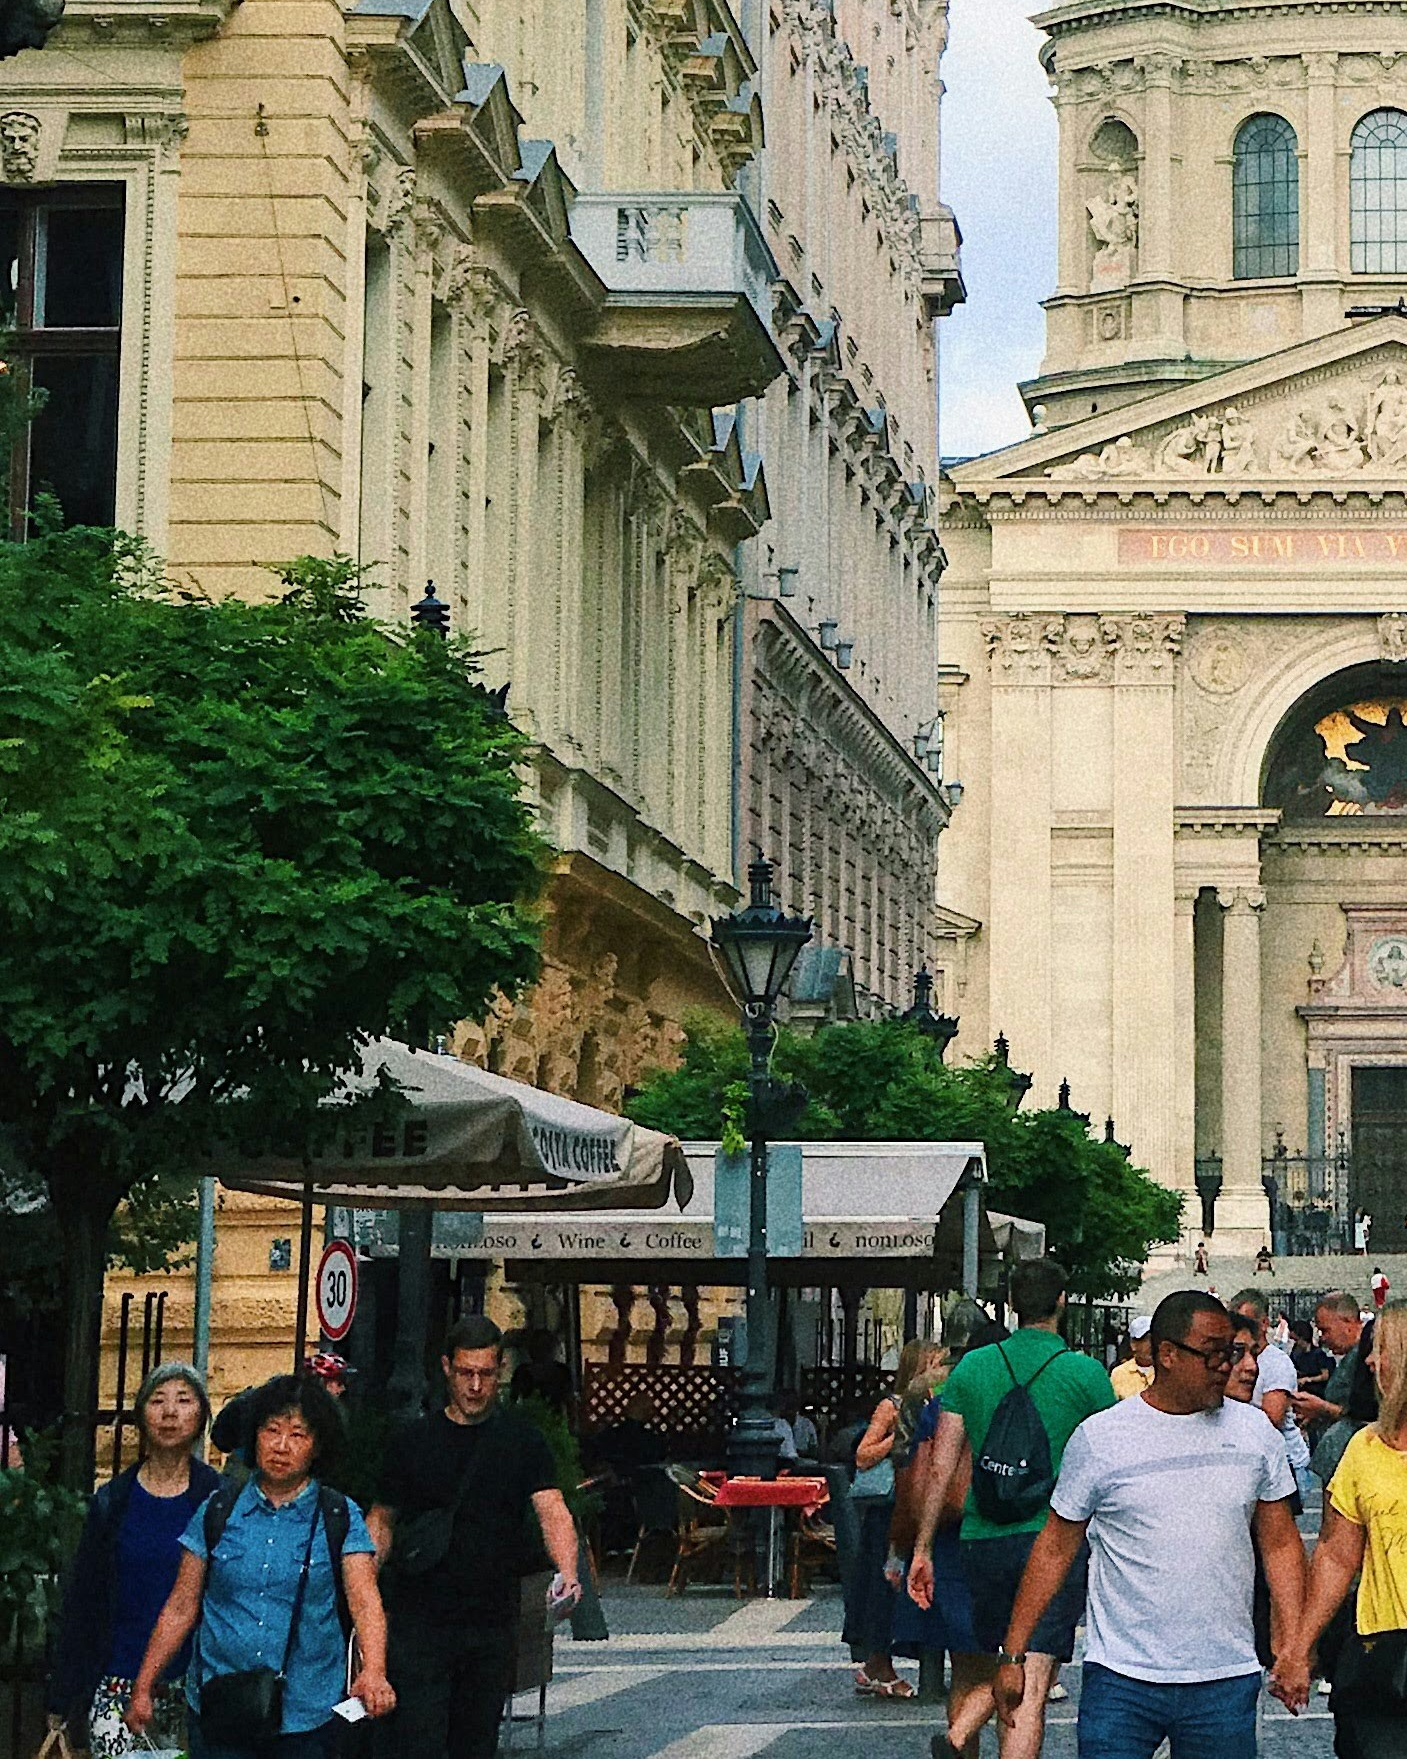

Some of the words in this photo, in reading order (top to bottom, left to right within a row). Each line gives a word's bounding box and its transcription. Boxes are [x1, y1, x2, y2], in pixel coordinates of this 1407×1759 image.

[1150, 535, 1210, 558] EGO
[1230, 534, 1294, 558] SUM
[1316, 534, 1366, 558] VIA
[573, 1135, 622, 1174] COFFEE
[558, 1233, 605, 1250] Wine
[645, 1232, 702, 1249] Coffee
[326, 1270, 347, 1308] 30
